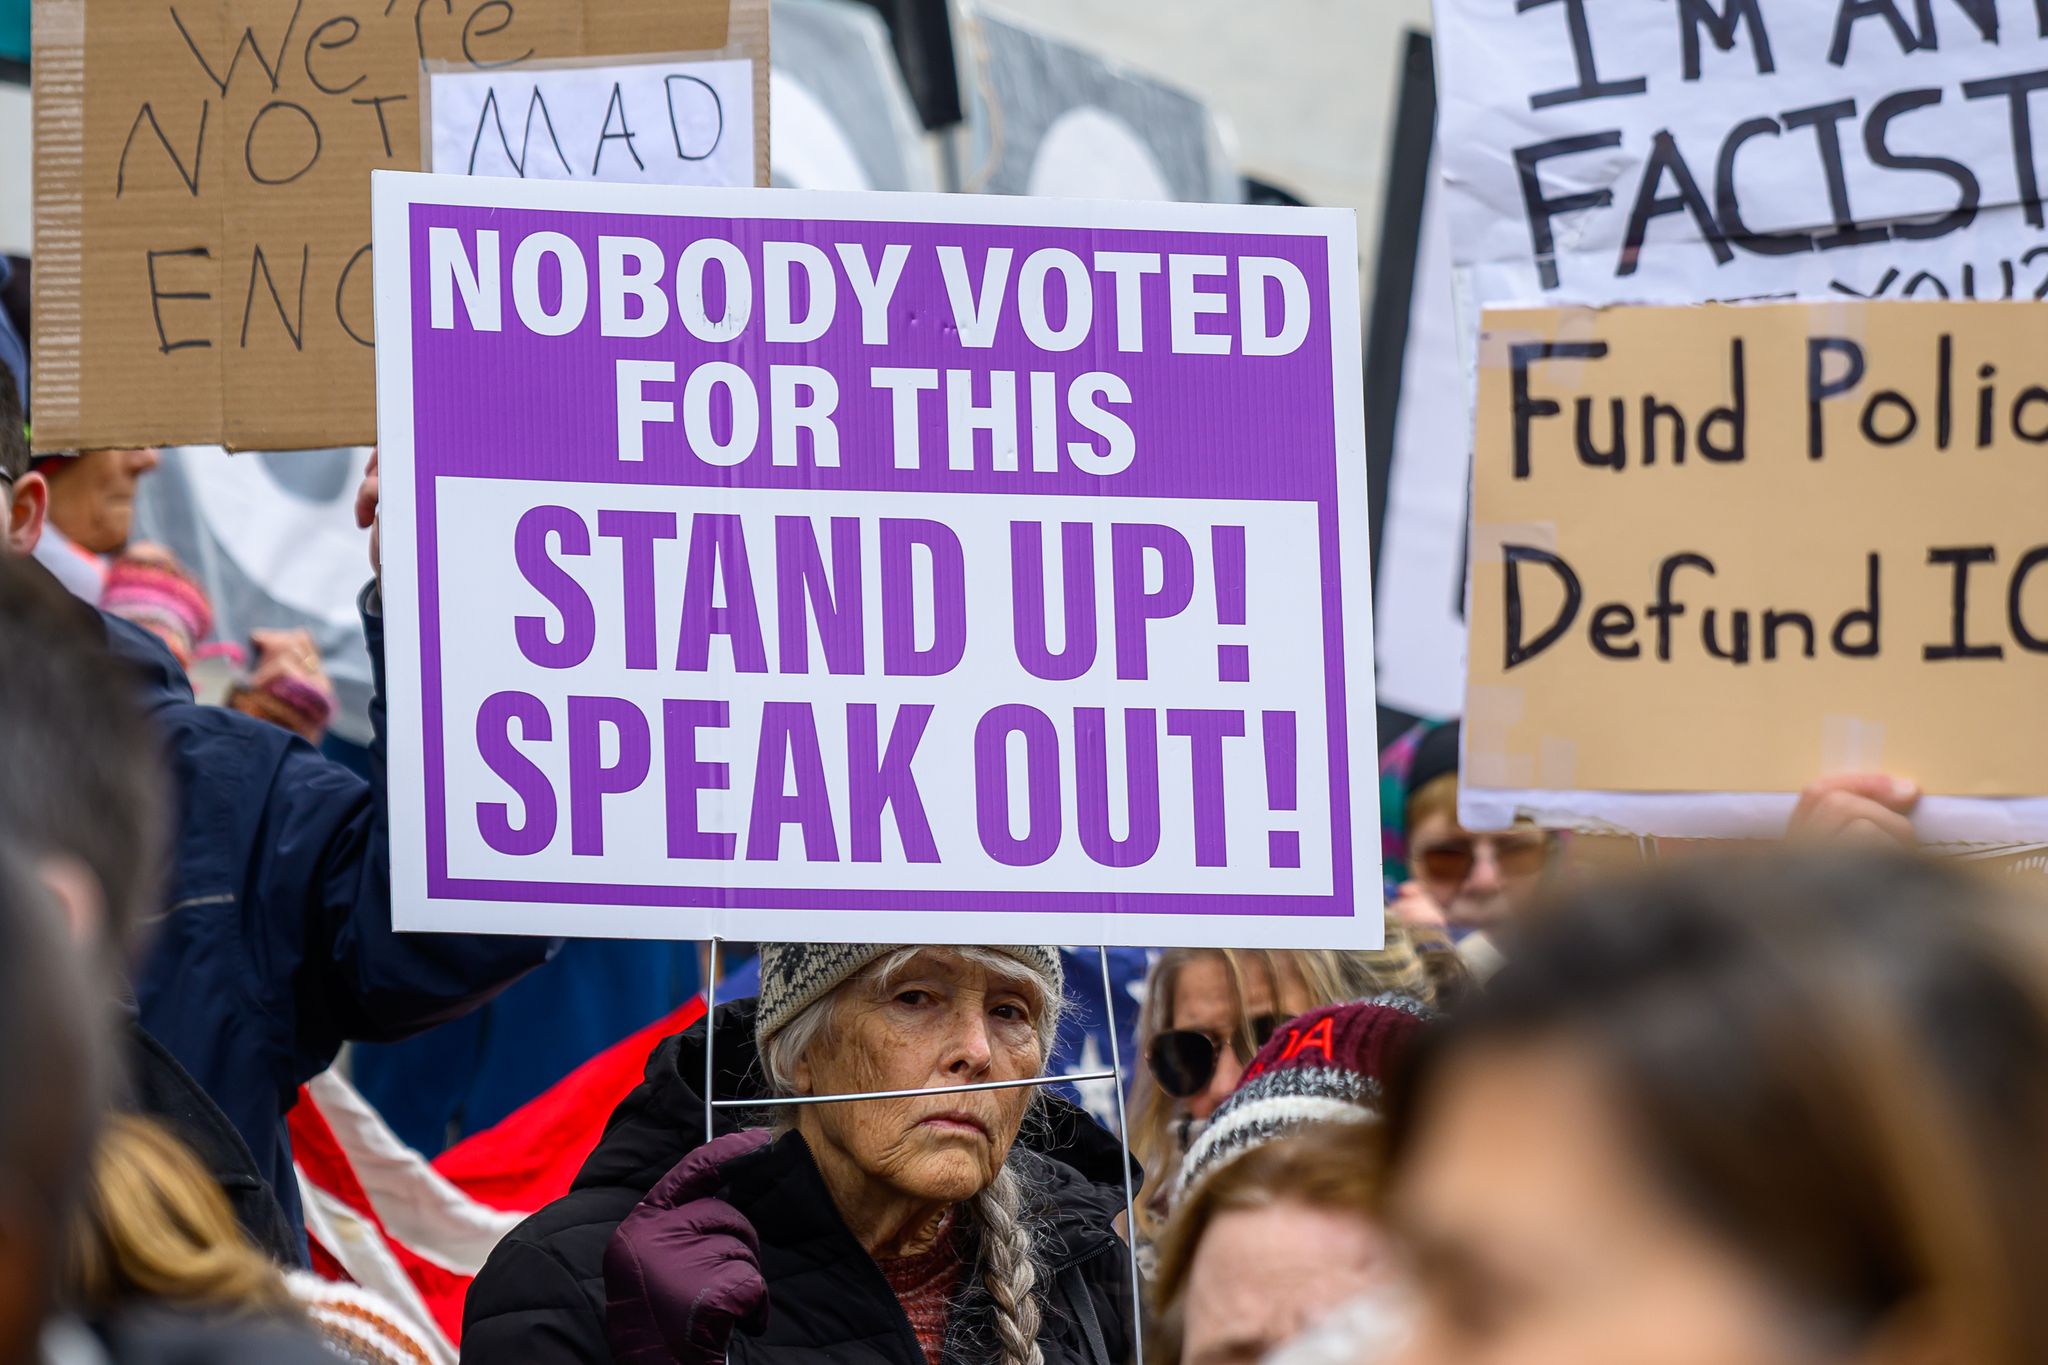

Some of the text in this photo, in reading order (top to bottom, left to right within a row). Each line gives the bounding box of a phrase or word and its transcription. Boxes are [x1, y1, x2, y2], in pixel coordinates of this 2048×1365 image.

[1516, 0, 2048, 110] IM AN
[116, 74, 724, 198] NOT MAD
[1513, 70, 2048, 290] FACIST
[428, 227, 1311, 357] NOBODY VOTED
[615, 360, 1137, 476] FOR THIS
[1508, 337, 1745, 480] Fund
[513, 505, 1251, 682] STAND UP!
[1500, 543, 1880, 671] Defund
[475, 690, 1302, 869] SPEAK OUT!
